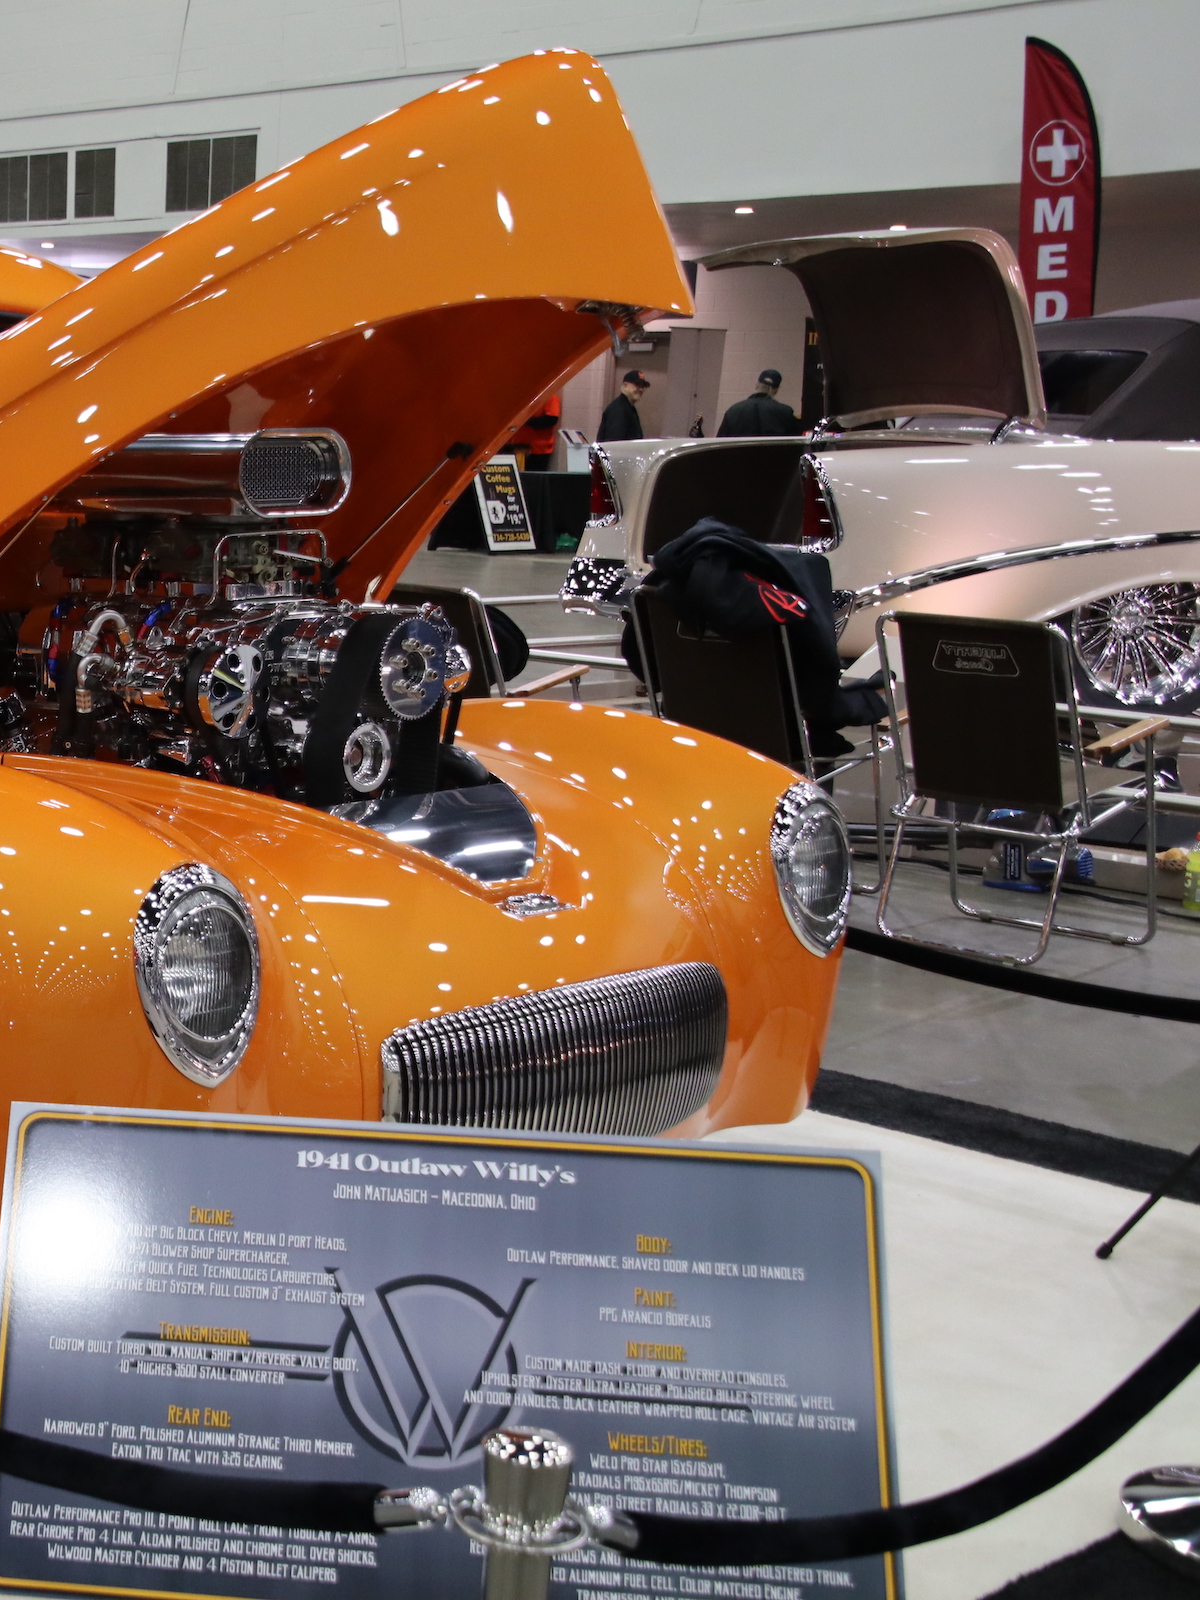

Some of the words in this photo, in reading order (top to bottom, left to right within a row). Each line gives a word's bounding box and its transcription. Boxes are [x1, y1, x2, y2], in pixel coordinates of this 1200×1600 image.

[1033, 196, 1075, 325] MED
[485, 475, 511, 483] Coffee
[495, 485, 516, 495] Mugs
[297, 1149, 349, 1169] 1941
[354, 1153, 466, 1177] Outlaw
[473, 1159, 576, 1189] Willy's
[332, 1182, 360, 1199] JOHN
[364, 1184, 427, 1203] MATIJASICH
[510, 1193, 535, 1210] OHIO
[190, 1206, 234, 1226] ENGINE:
[158, 1225, 174, 1239] BIG
[176, 1226, 205, 1241] BLOCK
[242, 1230, 276, 1246] MERLIN
[287, 1235, 311, 1248] PORT
[637, 1235, 672, 1254] BODY:
[152, 1243, 188, 1257] BLOWER
[190, 1245, 214, 1259] SHOP
[507, 1247, 546, 1264] OUTLAW
[622, 1256, 660, 1271] SHAVED
[663, 1259, 688, 1272] DOOR
[691, 1261, 711, 1274] AND
[714, 1263, 738, 1276] DECK
[742, 1264, 757, 1277] LID
[759, 1265, 804, 1280] HANDLES
[148, 1261, 174, 1280] QUICK
[176, 1262, 198, 1281] FUEL
[202, 1263, 268, 1286] TECHNOLOGIES
[146, 1279, 166, 1292] BELT
[209, 1282, 231, 1296] FULL
[232, 1285, 269, 1299] CUSTOM
[285, 1289, 327, 1303] EXHAUST
[330, 1292, 364, 1306] SYSTEM
[635, 1288, 675, 1307] PAINT:
[598, 1307, 618, 1321] PPG
[620, 1308, 662, 1324] ARANCIO
[665, 1311, 711, 1328] BOREALIS
[160, 1322, 250, 1346] TRANSMISSION:
[49, 1336, 84, 1351] CUSTOM
[87, 1340, 112, 1353] BUILT
[116, 1340, 145, 1355] TURBO
[170, 1346, 207, 1360] MANUAL
[211, 1349, 238, 1362] SHIFT
[241, 1350, 295, 1366] W/REVERSE
[300, 1355, 330, 1368] VALVE
[627, 1342, 685, 1361] INTERIOR:
[136, 1360, 172, 1376] HUGHES
[174, 1362, 198, 1376] 3500
[199, 1365, 226, 1380] STALL
[229, 1368, 285, 1384] CONVERTER
[524, 1355, 562, 1371] CUSTOM
[564, 1359, 592, 1373] MADE
[626, 1364, 656, 1377] FLOOR
[660, 1366, 680, 1379] AND
[682, 1367, 734, 1383] OVERHEAD
[546, 1374, 582, 1391] OYSTER
[584, 1378, 615, 1393] ULTRA
[666, 1383, 712, 1400] POLISHED
[716, 1389, 747, 1403] BILLET
[750, 1391, 796, 1407] STEERING
[800, 1395, 833, 1410] WHEEL
[168, 1405, 200, 1425] REAR
[204, 1408, 230, 1428] END:
[464, 1390, 483, 1405] AND
[486, 1391, 510, 1405] DOOR
[563, 1394, 594, 1411] BLACK
[597, 1398, 640, 1415] LEATHER
[642, 1402, 692, 1419] WRAPPED
[695, 1406, 716, 1420] ROLL
[751, 1409, 793, 1426] VINTAGE
[797, 1413, 814, 1428] AIR
[817, 1416, 855, 1431] SYSTEM
[43, 1418, 96, 1436] NARROWED
[140, 1425, 184, 1443] POLISHED
[186, 1429, 235, 1446] ALUMINUM
[238, 1432, 280, 1450] STRANGE
[282, 1436, 312, 1452] THIRD
[609, 1432, 707, 1457] WHEELS/TIRES:
[111, 1442, 142, 1458] EATON
[145, 1444, 163, 1460] TRU
[166, 1446, 191, 1462] TRAC
[194, 1450, 219, 1464] WITH
[221, 1450, 240, 1466] 3:25
[243, 1454, 282, 1469] GEARING
[589, 1453, 618, 1470] WELD
[620, 1455, 639, 1471] PRO
[642, 1456, 668, 1474] STAR
[578, 1471, 621, 1489] RADIALS
[723, 1482, 776, 1501] THOMPSON
[10, 1500, 50, 1517] OUTLAW
[54, 1504, 120, 1524] PERFORMANCE
[123, 1509, 142, 1525] PRO
[158, 1512, 165, 1526] 8
[168, 1516, 195, 1530] POINT
[616, 1494, 652, 1511] STREET
[656, 1497, 699, 1515] RADIALS
[700, 1501, 714, 1514] 33
[10, 1520, 34, 1536] REAR
[36, 1522, 73, 1540] CHROME
[76, 1525, 95, 1541] PRO
[98, 1528, 108, 1543] 4
[139, 1530, 172, 1548] ALDAN
[174, 1534, 220, 1552] POLISHED
[222, 1538, 244, 1554] AND
[245, 1541, 283, 1557] CHROME
[286, 1544, 305, 1558] COIL
[309, 1546, 336, 1562] OVER
[47, 1542, 91, 1561] WILWOOD
[94, 1546, 132, 1564] MASTER
[134, 1549, 179, 1568] CYLINDER
[182, 1555, 202, 1570] AND
[206, 1557, 216, 1572] 4
[219, 1556, 253, 1574] PISTON
[256, 1560, 286, 1577] BILLET
[290, 1564, 336, 1581] CALIPERS
[568, 1568, 620, 1586] ALUMINUM
[623, 1573, 646, 1588] FUEL
[679, 1576, 710, 1593] COLOR
[713, 1580, 761, 1599] MATCHED
